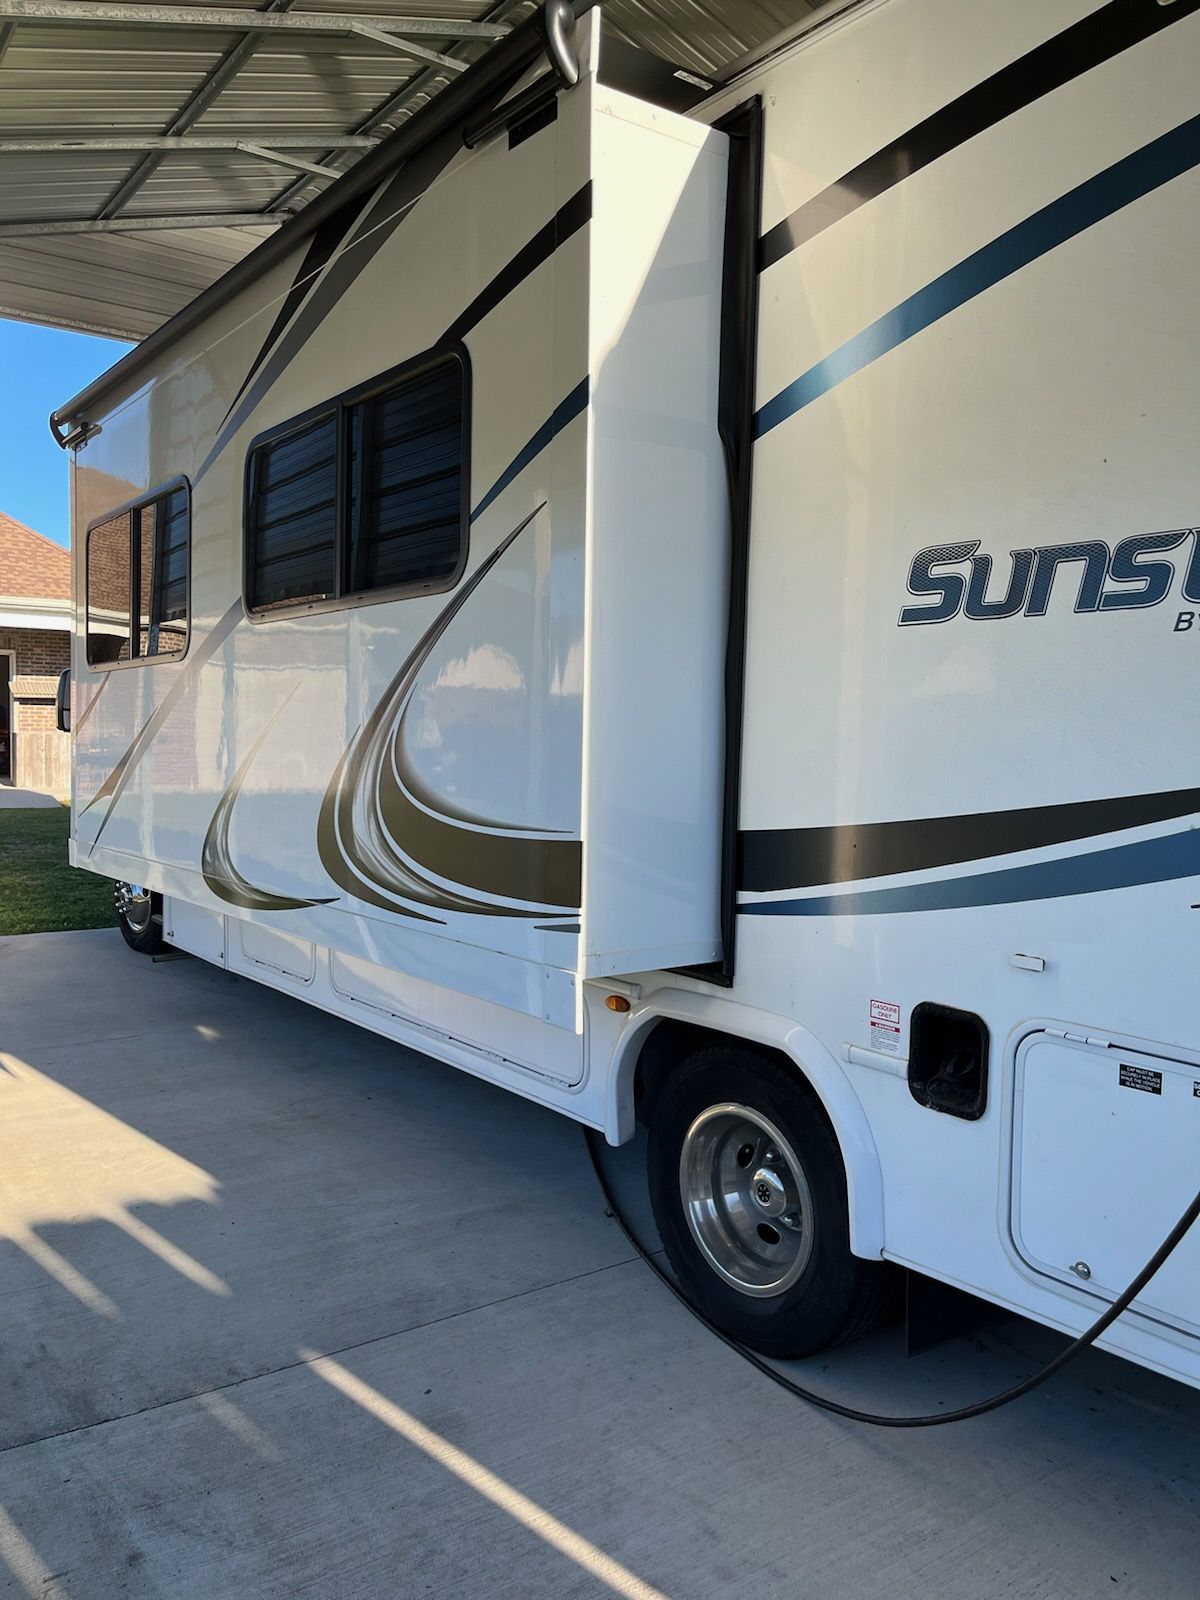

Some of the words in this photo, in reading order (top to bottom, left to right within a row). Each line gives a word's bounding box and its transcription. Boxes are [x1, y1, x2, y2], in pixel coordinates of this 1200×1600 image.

[1173, 611, 1200, 632] B
[872, 1003, 897, 1013] GASOLINE
[877, 1011, 892, 1019] ONLY
[1120, 1070, 1141, 1078] SECURELY
[1142, 1080, 1160, 1088] VEHICLE
